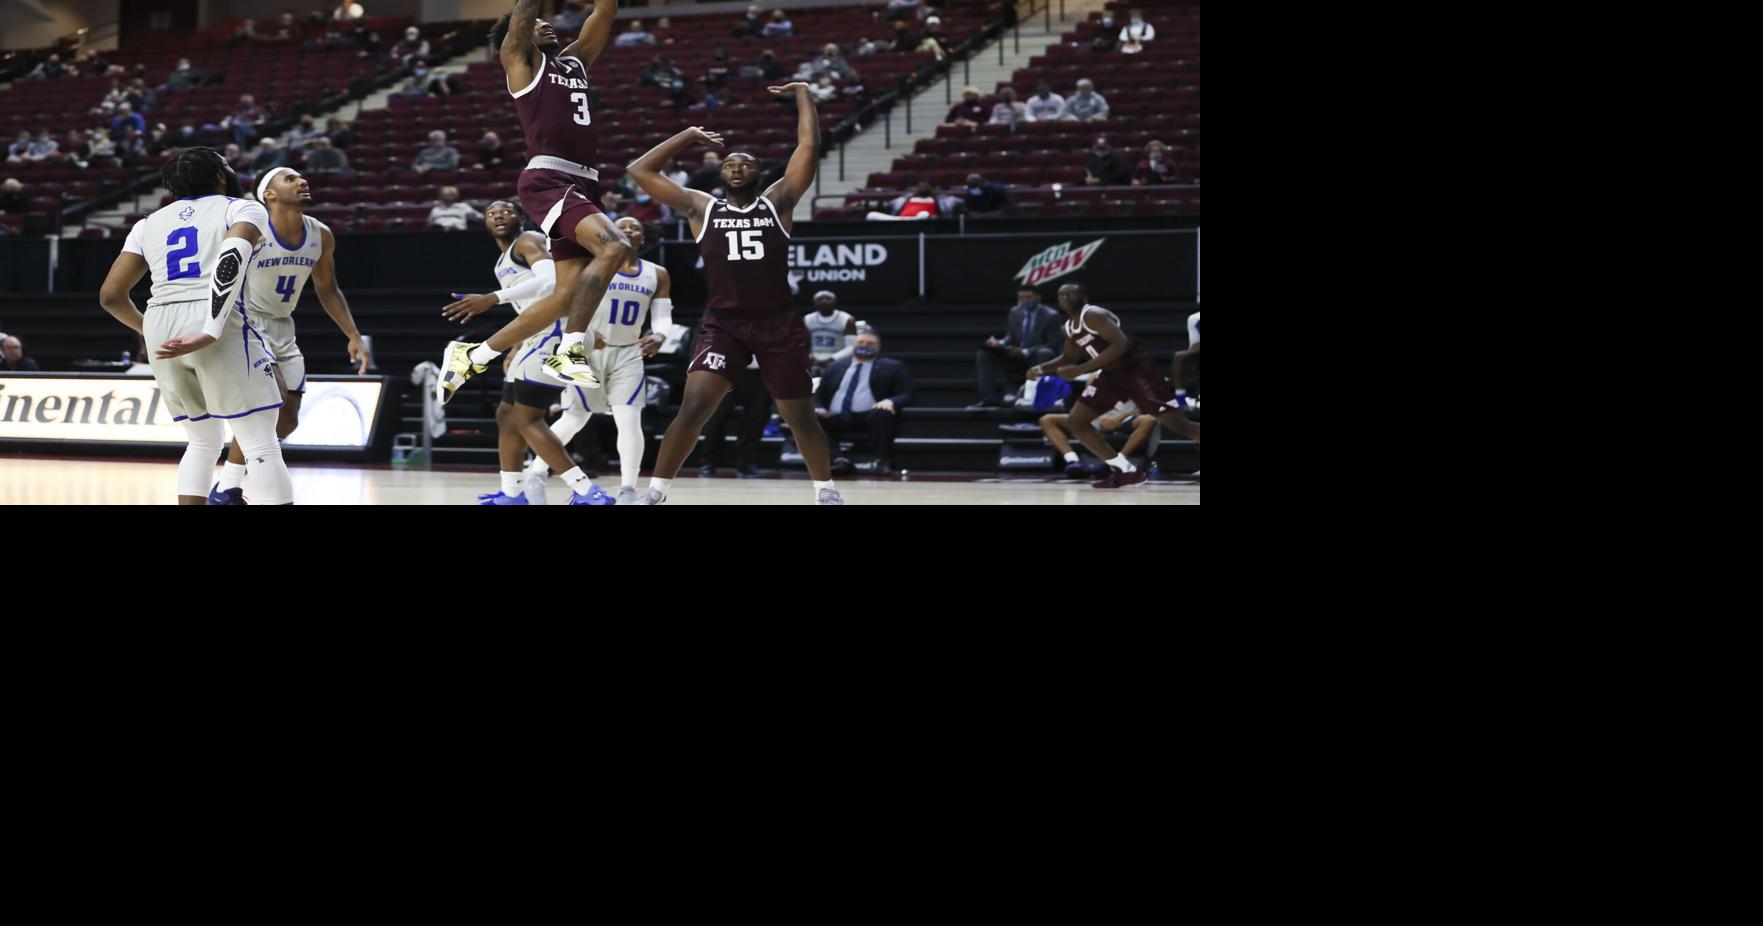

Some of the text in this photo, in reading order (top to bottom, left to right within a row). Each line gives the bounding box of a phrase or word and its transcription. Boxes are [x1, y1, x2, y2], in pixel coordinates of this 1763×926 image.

[548, 73, 584, 89] TEXAS
[570, 92, 591, 126] 3
[713, 217, 775, 229] TEXAS A&M
[166, 225, 201, 281] 2
[725, 230, 765, 261] 15
[257, 257, 283, 269] NEW
[807, 269, 866, 282] UNION
[275, 275, 297, 303] 4
[608, 298, 640, 326] 10
